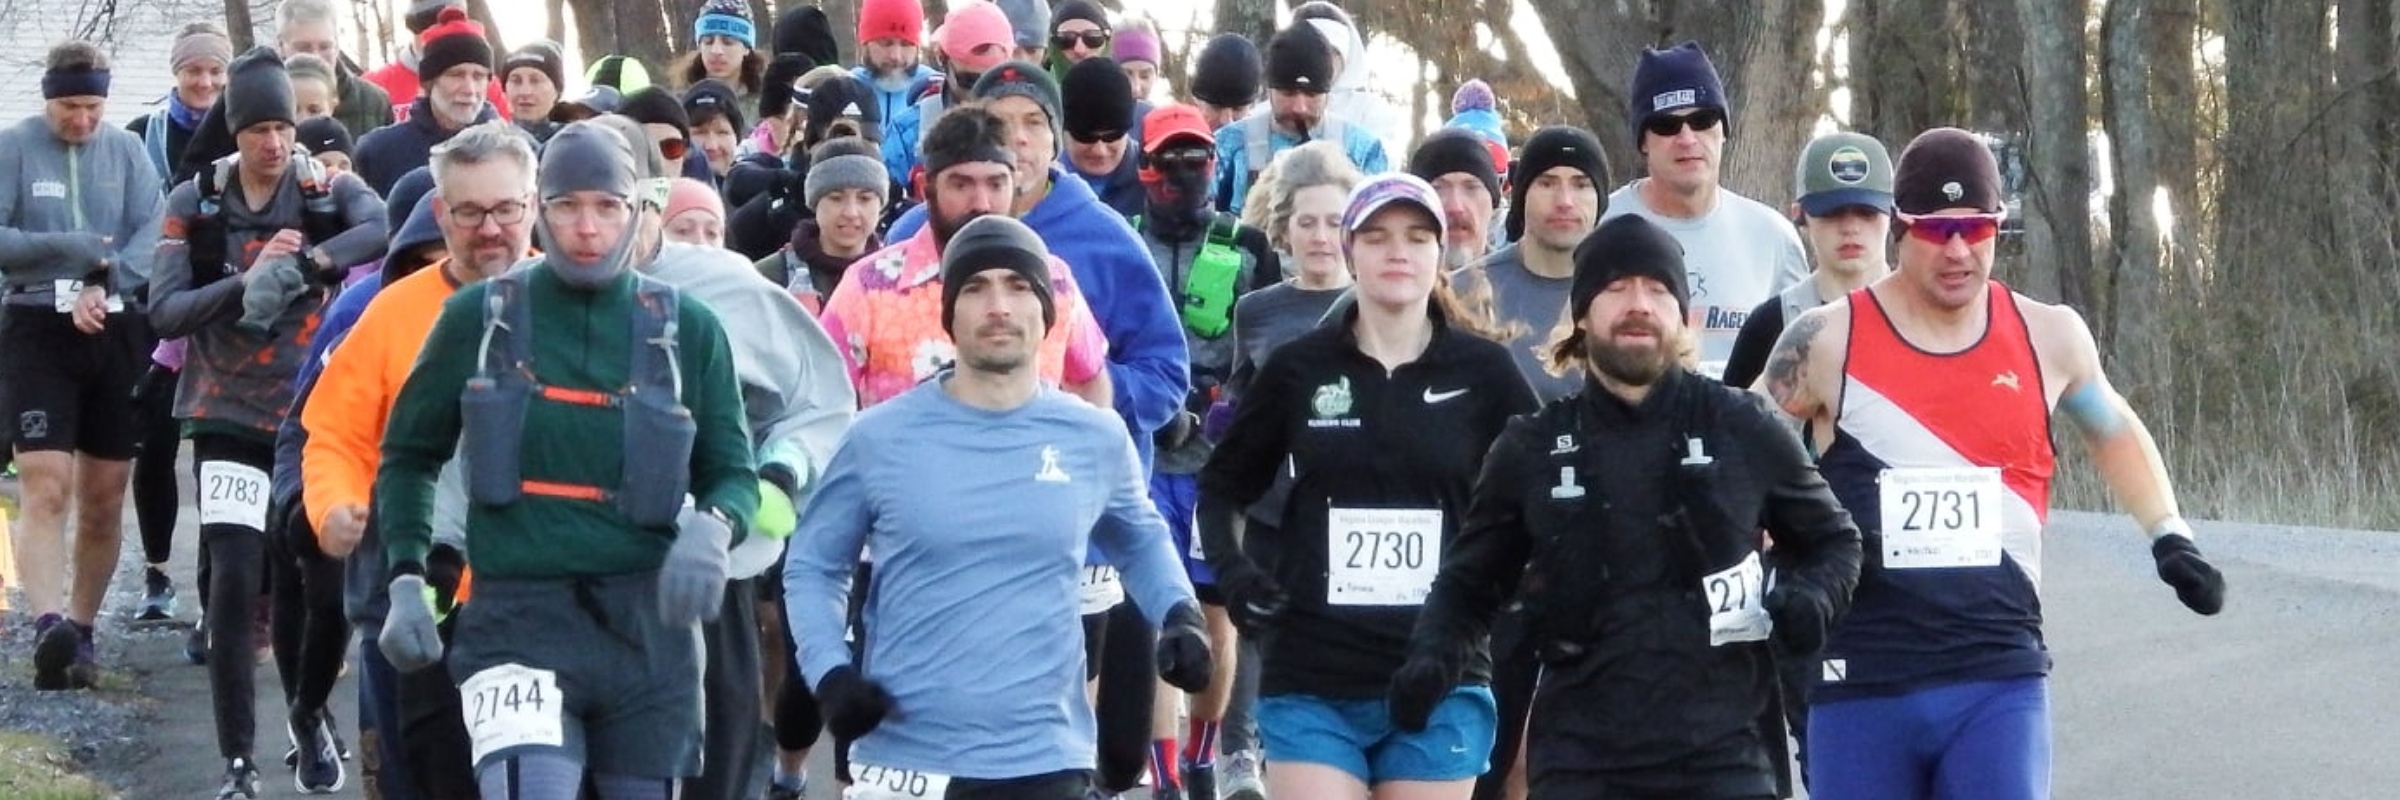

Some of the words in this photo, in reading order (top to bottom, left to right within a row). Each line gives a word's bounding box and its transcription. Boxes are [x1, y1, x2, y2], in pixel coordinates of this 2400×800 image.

[210, 474, 260, 506] 2783
[1902, 490, 1980, 531] 2731
[1346, 530, 1424, 570] 2730
[1710, 569, 1746, 614] 27
[472, 677, 545, 728] 2744
